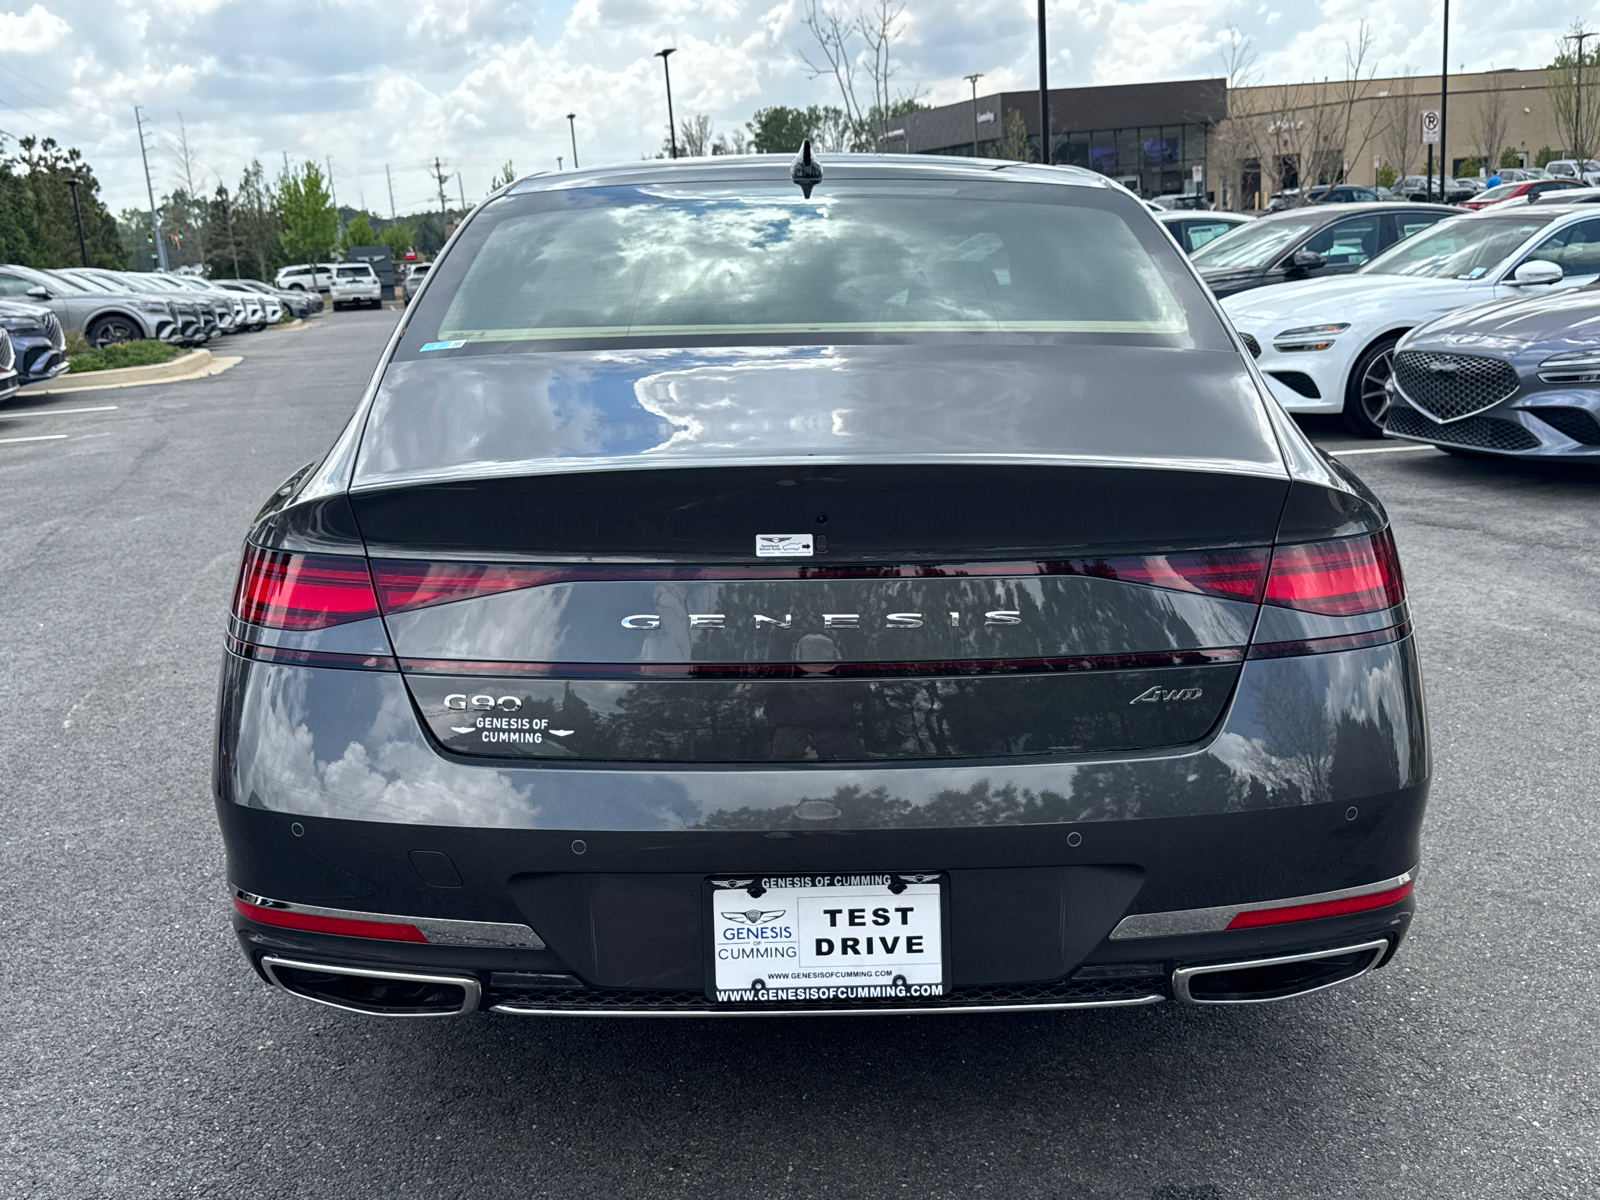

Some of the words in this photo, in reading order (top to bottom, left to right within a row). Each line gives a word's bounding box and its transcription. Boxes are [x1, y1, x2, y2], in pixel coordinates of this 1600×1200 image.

[621, 610, 1022, 630] GENESIS
[443, 693, 523, 712] G90
[476, 717, 530, 730] GENESIS
[532, 718, 549, 730] OF
[481, 731, 543, 744] CUMMING
[761, 876, 812, 889] GENESIS
[815, 876, 831, 887] OF
[833, 874, 892, 887] CUMMING
[823, 906, 915, 928] TEST
[723, 926, 792, 941] GENESIS
[718, 946, 797, 960] CUMMING
[815, 935, 925, 956] DRIVE
[767, 969, 893, 980] WWW.GENESISOFCUMMING.COM
[716, 983, 943, 1002] WWW.GENESISOFCUMMING.COM
